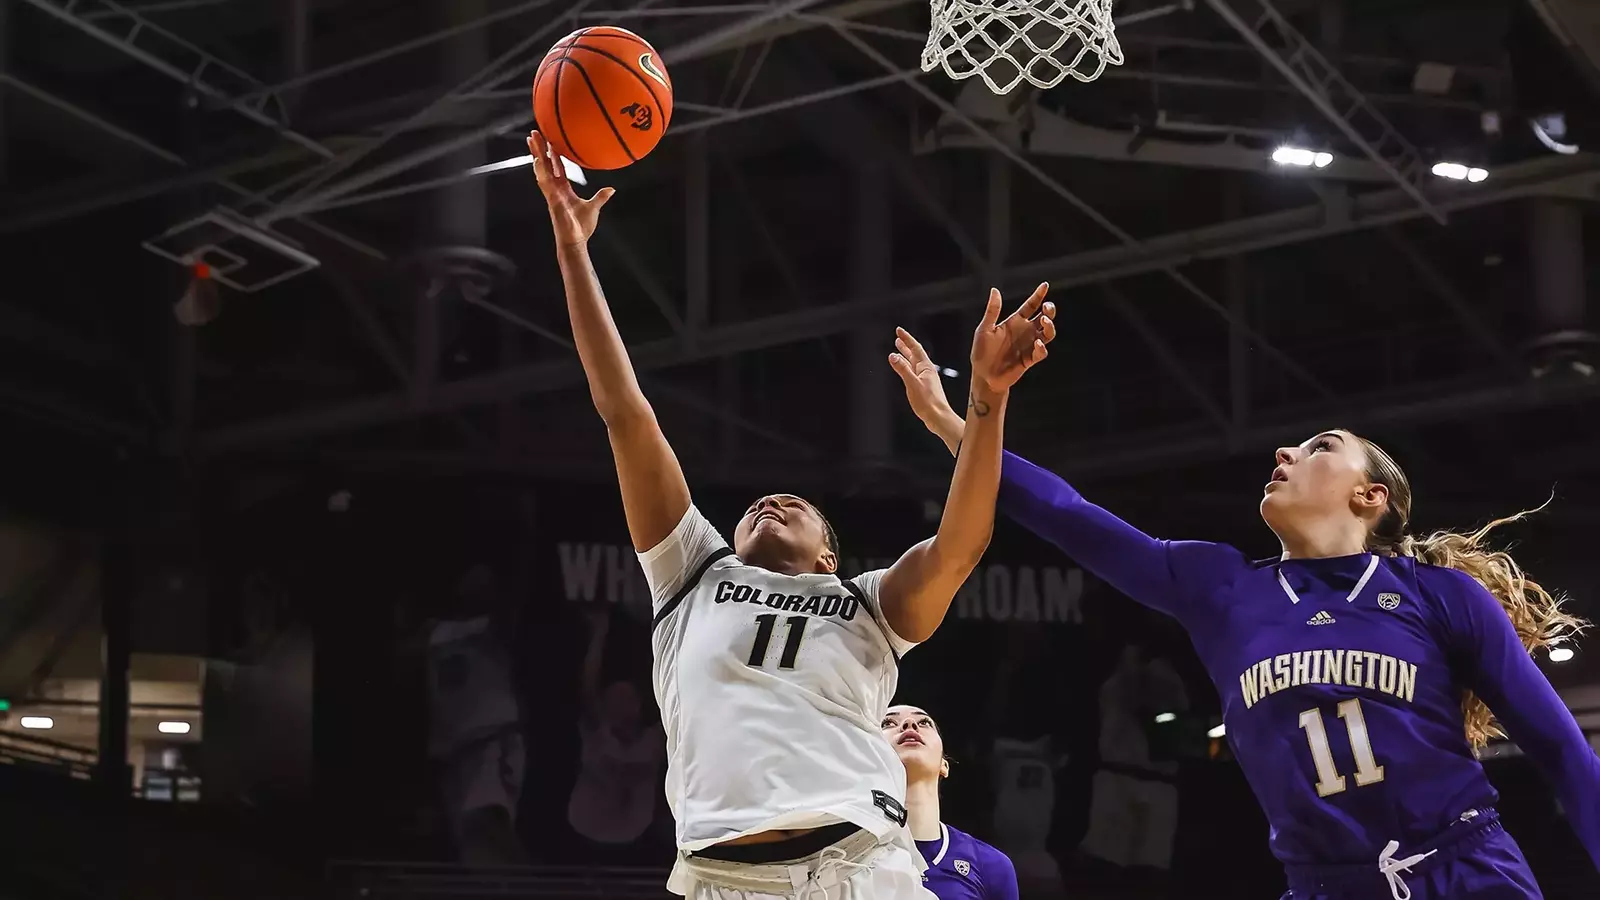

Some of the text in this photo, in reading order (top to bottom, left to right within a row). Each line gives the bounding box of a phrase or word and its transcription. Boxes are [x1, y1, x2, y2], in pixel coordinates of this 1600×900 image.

[714, 580, 859, 621] COLORADO
[1306, 618, 1336, 626] adidas
[746, 613, 810, 671] 11
[1239, 649, 1418, 710] WASHINGTON
[1299, 697, 1385, 798] 11
